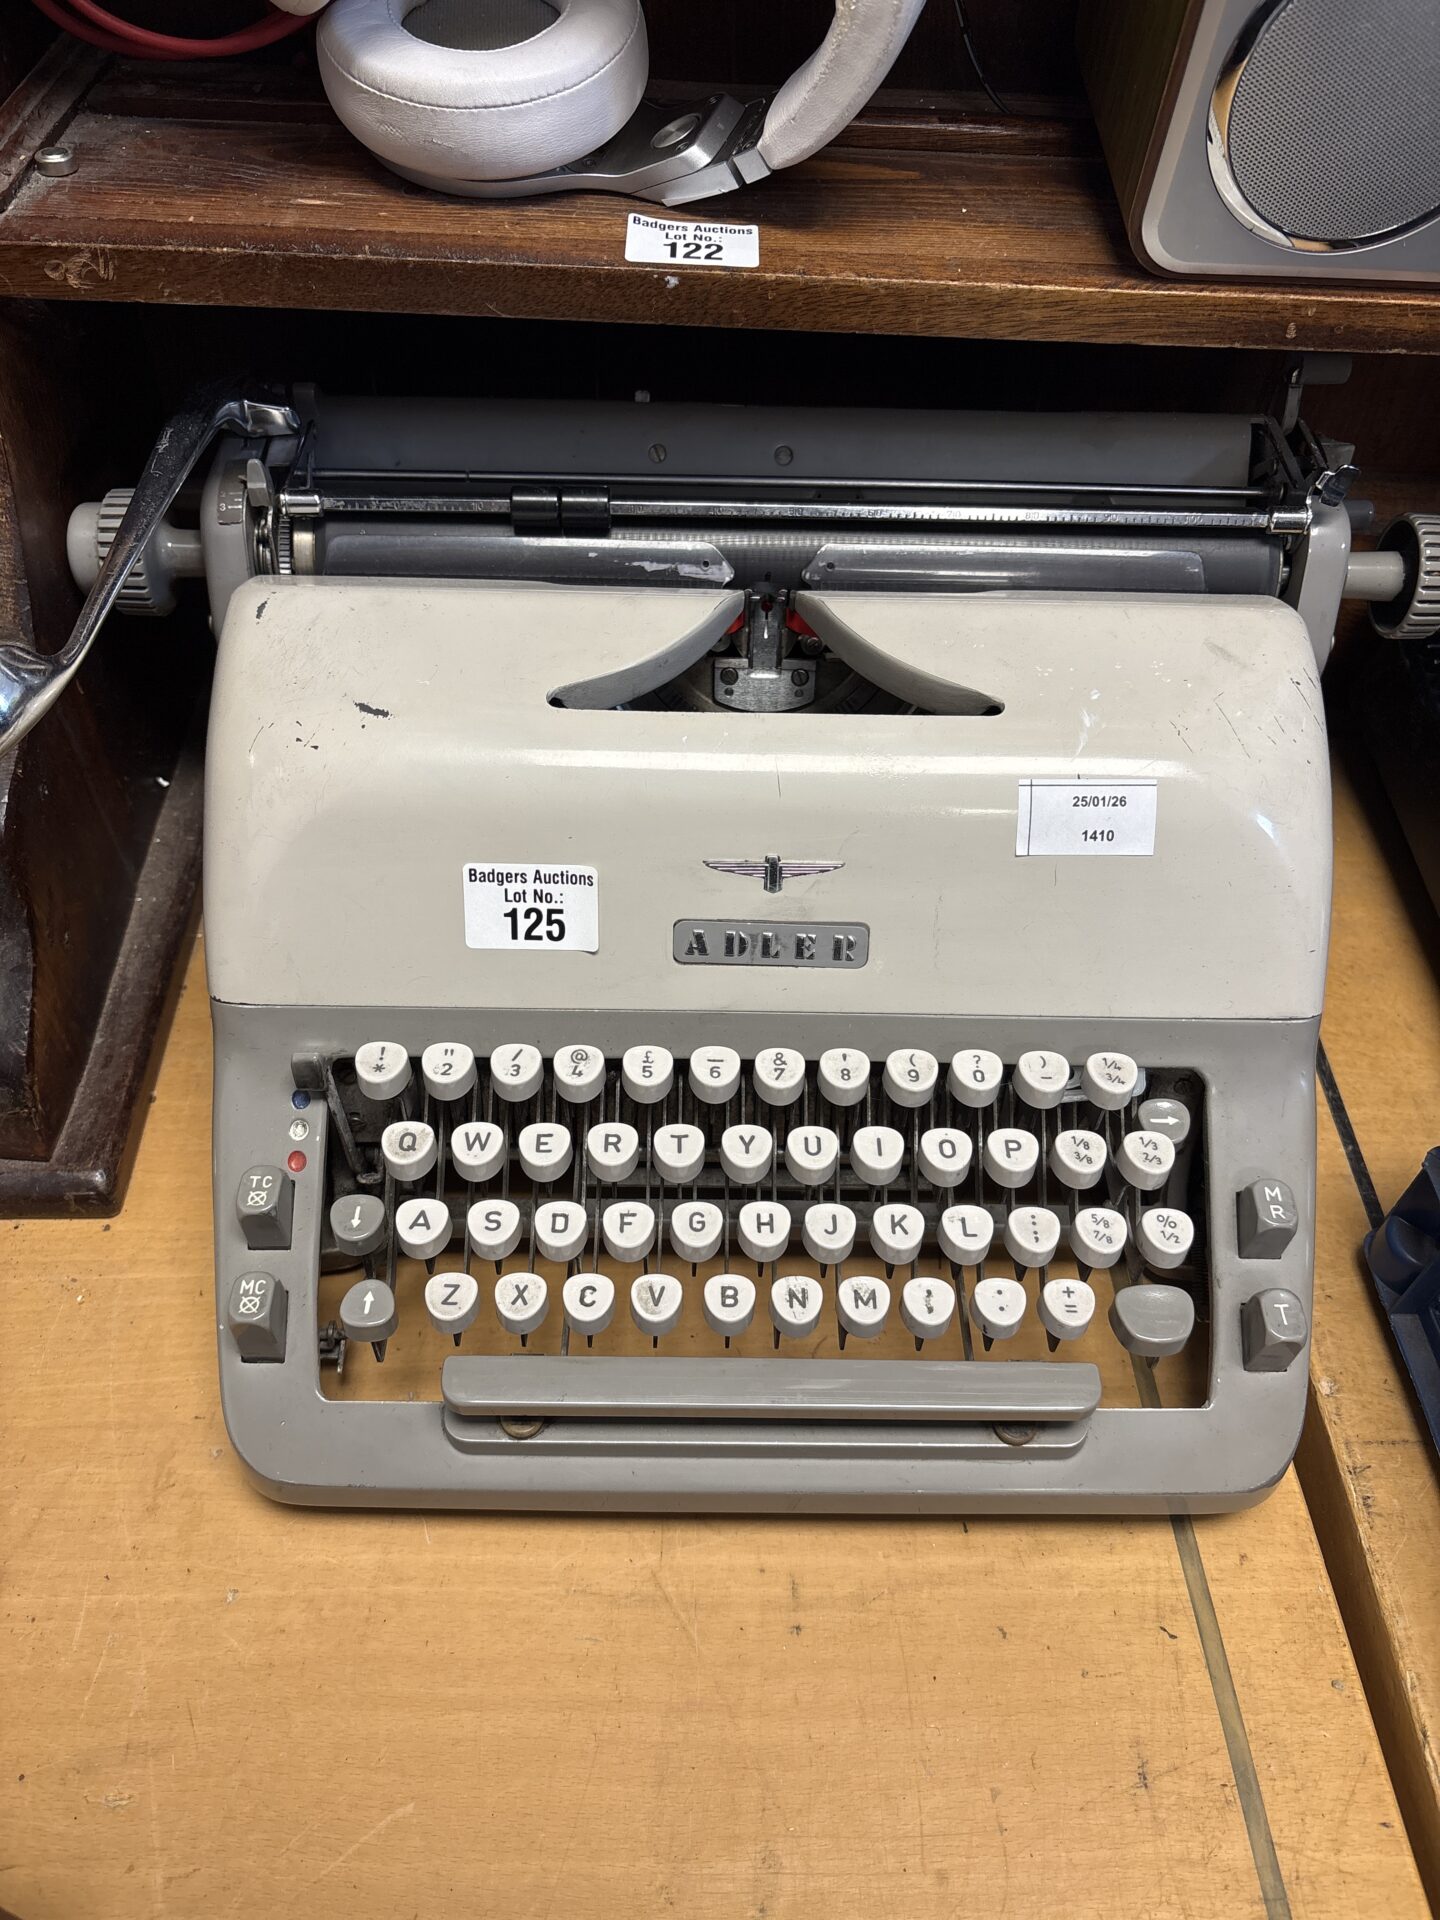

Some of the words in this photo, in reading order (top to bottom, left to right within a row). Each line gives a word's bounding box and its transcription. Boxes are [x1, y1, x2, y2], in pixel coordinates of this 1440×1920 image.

[632, 215, 688, 232] Badgers
[693, 224, 753, 235] Auctions
[665, 232, 687, 241] Lot
[693, 234, 723, 243] No.:
[663, 242, 724, 261] 122
[219, 502, 227, 512] 3
[1072, 796, 1127, 808] 25/01/26
[1081, 830, 1115, 842] 1410
[469, 868, 528, 887] Badgers
[533, 869, 594, 887] Auctions
[504, 888, 527, 904] Lot
[533, 889, 564, 904] No.:
[503, 907, 566, 942] 125
[685, 929, 857, 961] ADLER
[570, 1048, 588, 1065] @
[641, 1050, 655, 1065] £
[772, 1051, 788, 1067] &
[908, 1053, 917, 1068] (
[972, 1054, 982, 1069] ?
[1039, 1055, 1047, 1069] )
[440, 1062, 454, 1076] 2
[509, 1063, 522, 1077] 3
[571, 1064, 584, 1078] 4
[641, 1065, 654, 1079] 5
[709, 1065, 722, 1079] 6
[773, 1067, 786, 1081] 7
[840, 1067, 852, 1082] 8
[907, 1068, 920, 1083] 9
[398, 1131, 417, 1153] Q
[464, 1131, 492, 1152] W
[535, 1133, 554, 1154] E
[603, 1133, 622, 1154] R
[669, 1133, 690, 1155] T
[738, 1134, 756, 1155] Y
[803, 1135, 822, 1157] U
[876, 1137, 883, 1157] I
[938, 1138, 957, 1159] O
[1004, 1139, 1022, 1159] P
[1070, 1135, 1091, 1151] 1/8
[1138, 1136, 1159, 1151] 1/3
[1073, 1151, 1094, 1165] 3/8
[1142, 1151, 1163, 1166] 2/3
[249, 1175, 273, 1189] TC
[1264, 1186, 1283, 1202] M
[1269, 1204, 1287, 1220] R
[408, 1209, 431, 1231] A
[484, 1210, 503, 1232] S
[550, 1212, 570, 1234] D
[618, 1212, 638, 1234] F
[688, 1211, 706, 1233] G
[756, 1212, 775, 1234] H
[823, 1213, 838, 1236] J
[890, 1213, 909, 1236] K
[960, 1216, 979, 1238] L
[1090, 1213, 1111, 1230] 5/8
[239, 1279, 267, 1295] MC
[440, 1283, 461, 1306] Z
[510, 1283, 529, 1307] X
[578, 1285, 598, 1308] C
[647, 1283, 666, 1308] V
[720, 1285, 739, 1308] B
[786, 1287, 809, 1310] N
[852, 1287, 878, 1310] M
[1273, 1303, 1290, 1326] T
